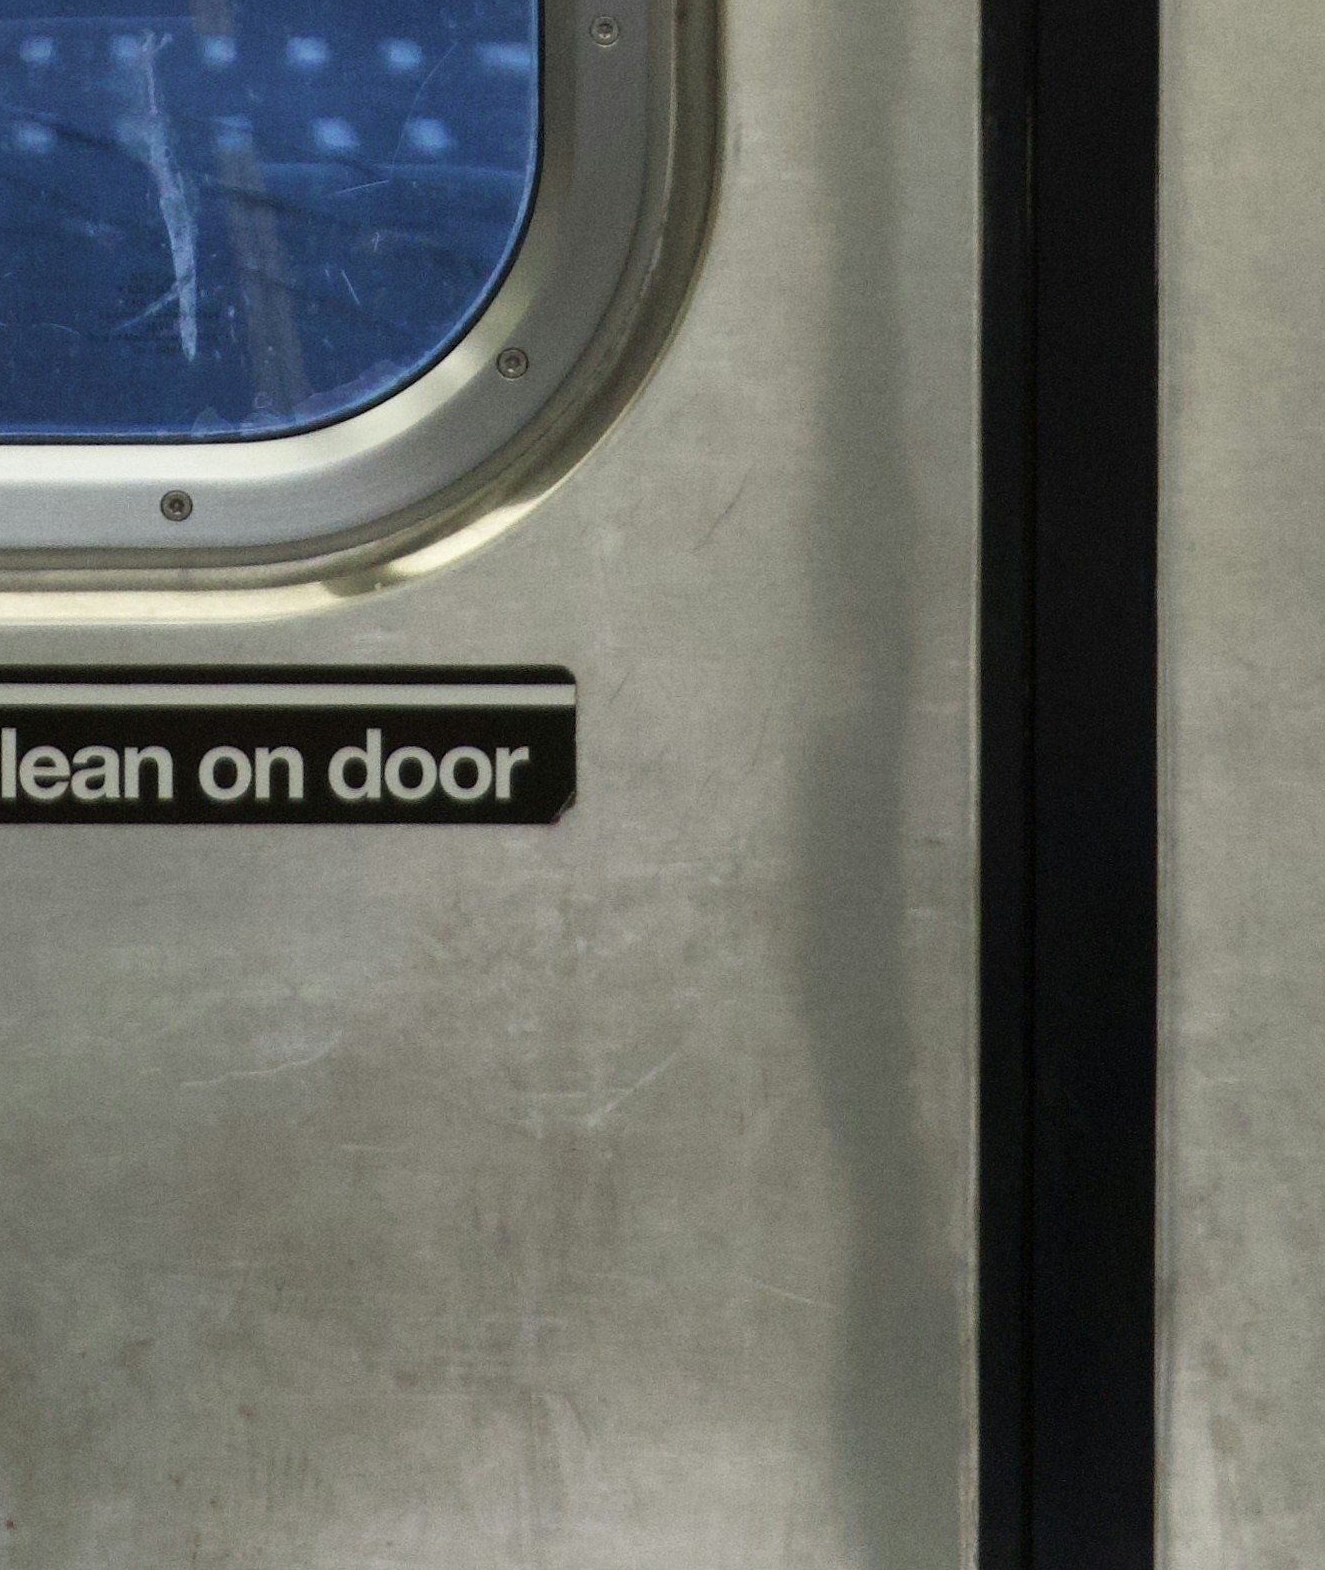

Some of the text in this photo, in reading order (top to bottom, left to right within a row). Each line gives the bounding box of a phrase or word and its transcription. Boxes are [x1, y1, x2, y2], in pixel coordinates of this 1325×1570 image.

[1, 726, 175, 802] lean
[197, 744, 305, 803] on
[327, 728, 531, 803] door
